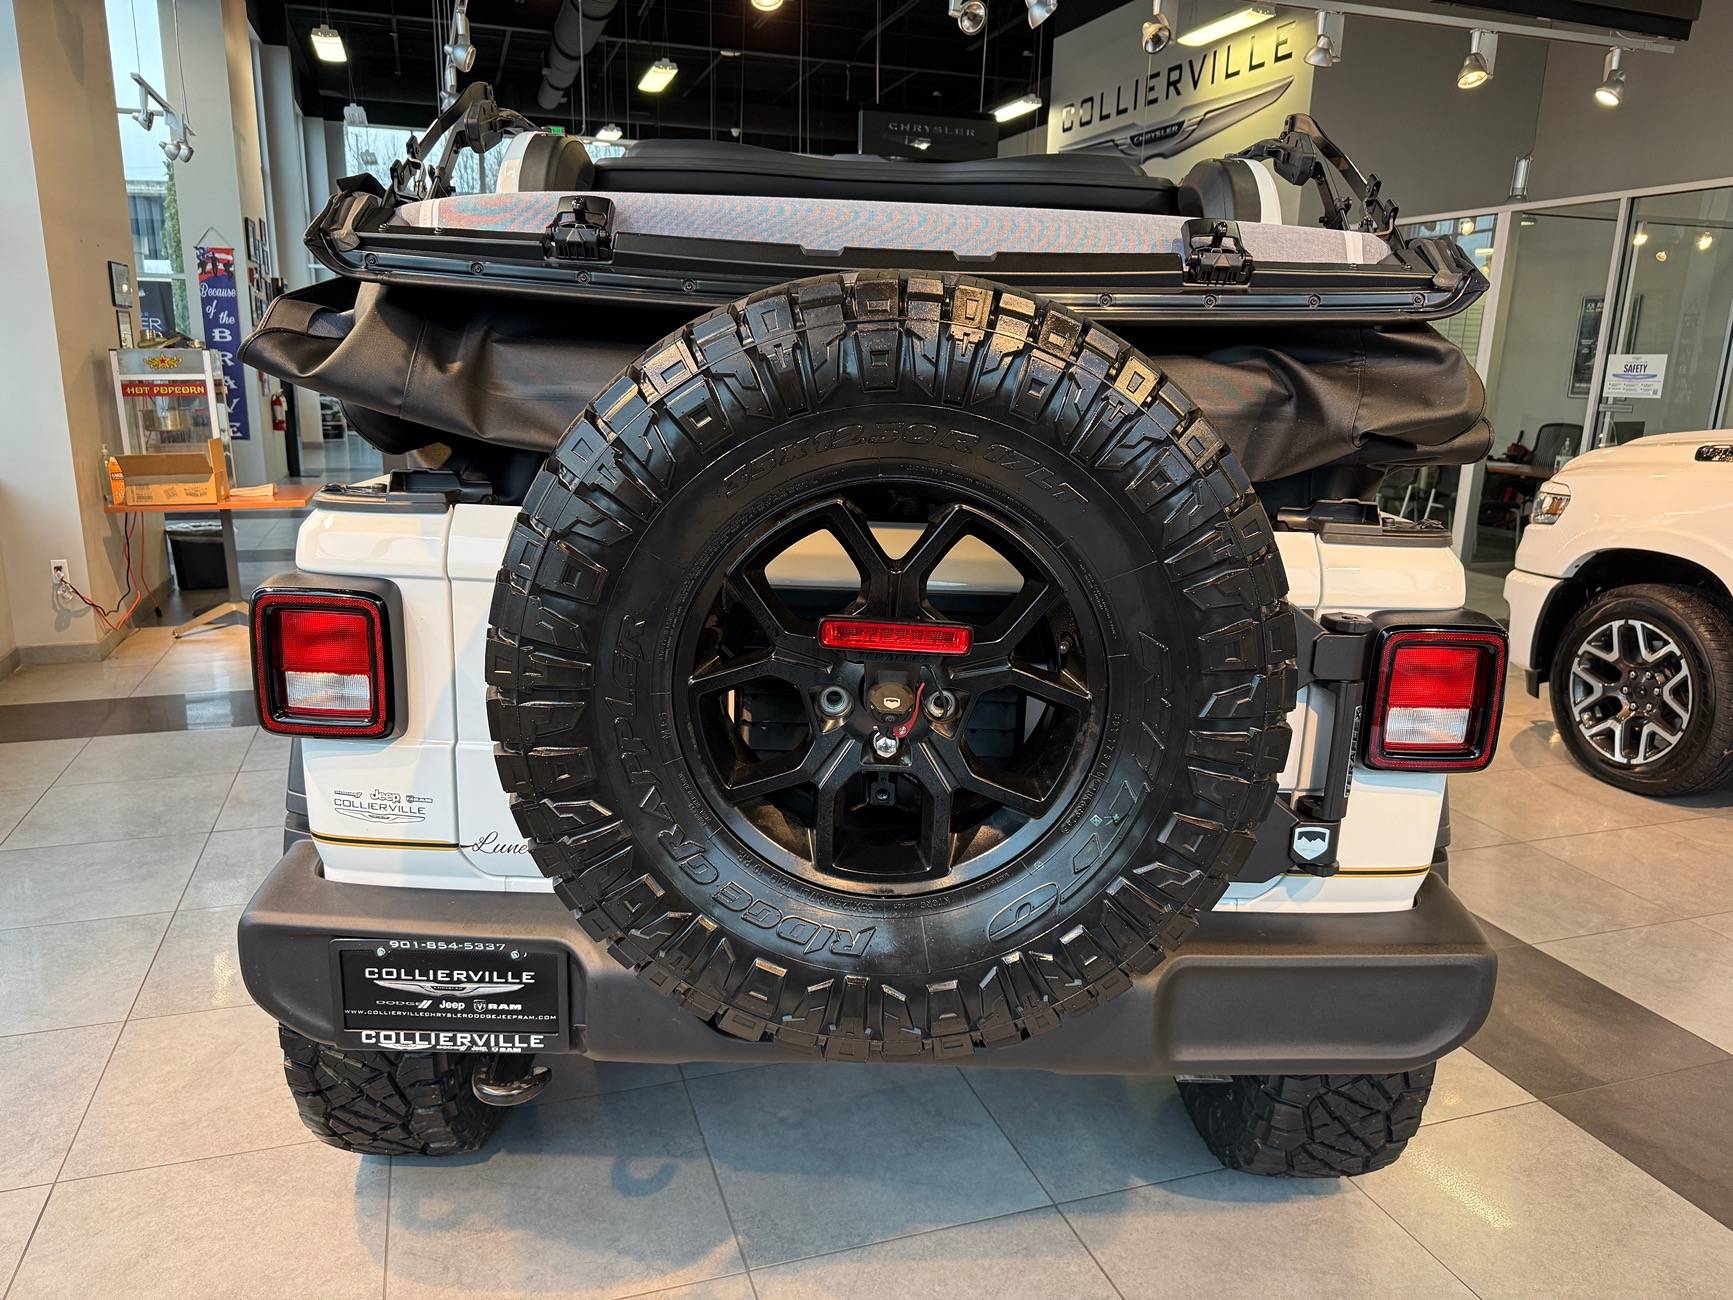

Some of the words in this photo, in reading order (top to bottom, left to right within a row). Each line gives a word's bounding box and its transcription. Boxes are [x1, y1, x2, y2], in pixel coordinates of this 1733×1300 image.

[1061, 19, 1298, 134] COLLIERVILLE
[888, 121, 976, 137] CHRYSLER
[1133, 123, 1180, 146] CHRYSLER
[200, 281, 236, 299] Because
[206, 300, 217, 319] of
[219, 310, 236, 325] the
[1624, 363, 1648, 374] SAFETY
[127, 386, 150, 395] HOT
[153, 386, 205, 395] POPCORN
[370, 788, 401, 804] Jeep
[334, 798, 426, 815] COLLIERVILLE
[711, 880, 878, 957] RIDGE
[389, 940, 505, 951] 901-854-5337
[365, 967, 535, 983] COLLIERVILLE
[439, 1000, 465, 1011] Jeep
[344, 1009, 557, 1020] WWW.COLLIERVILLECHRYSLERDODGEJEEPRAM.COM
[361, 1030, 545, 1048] COLLIERVILLE
